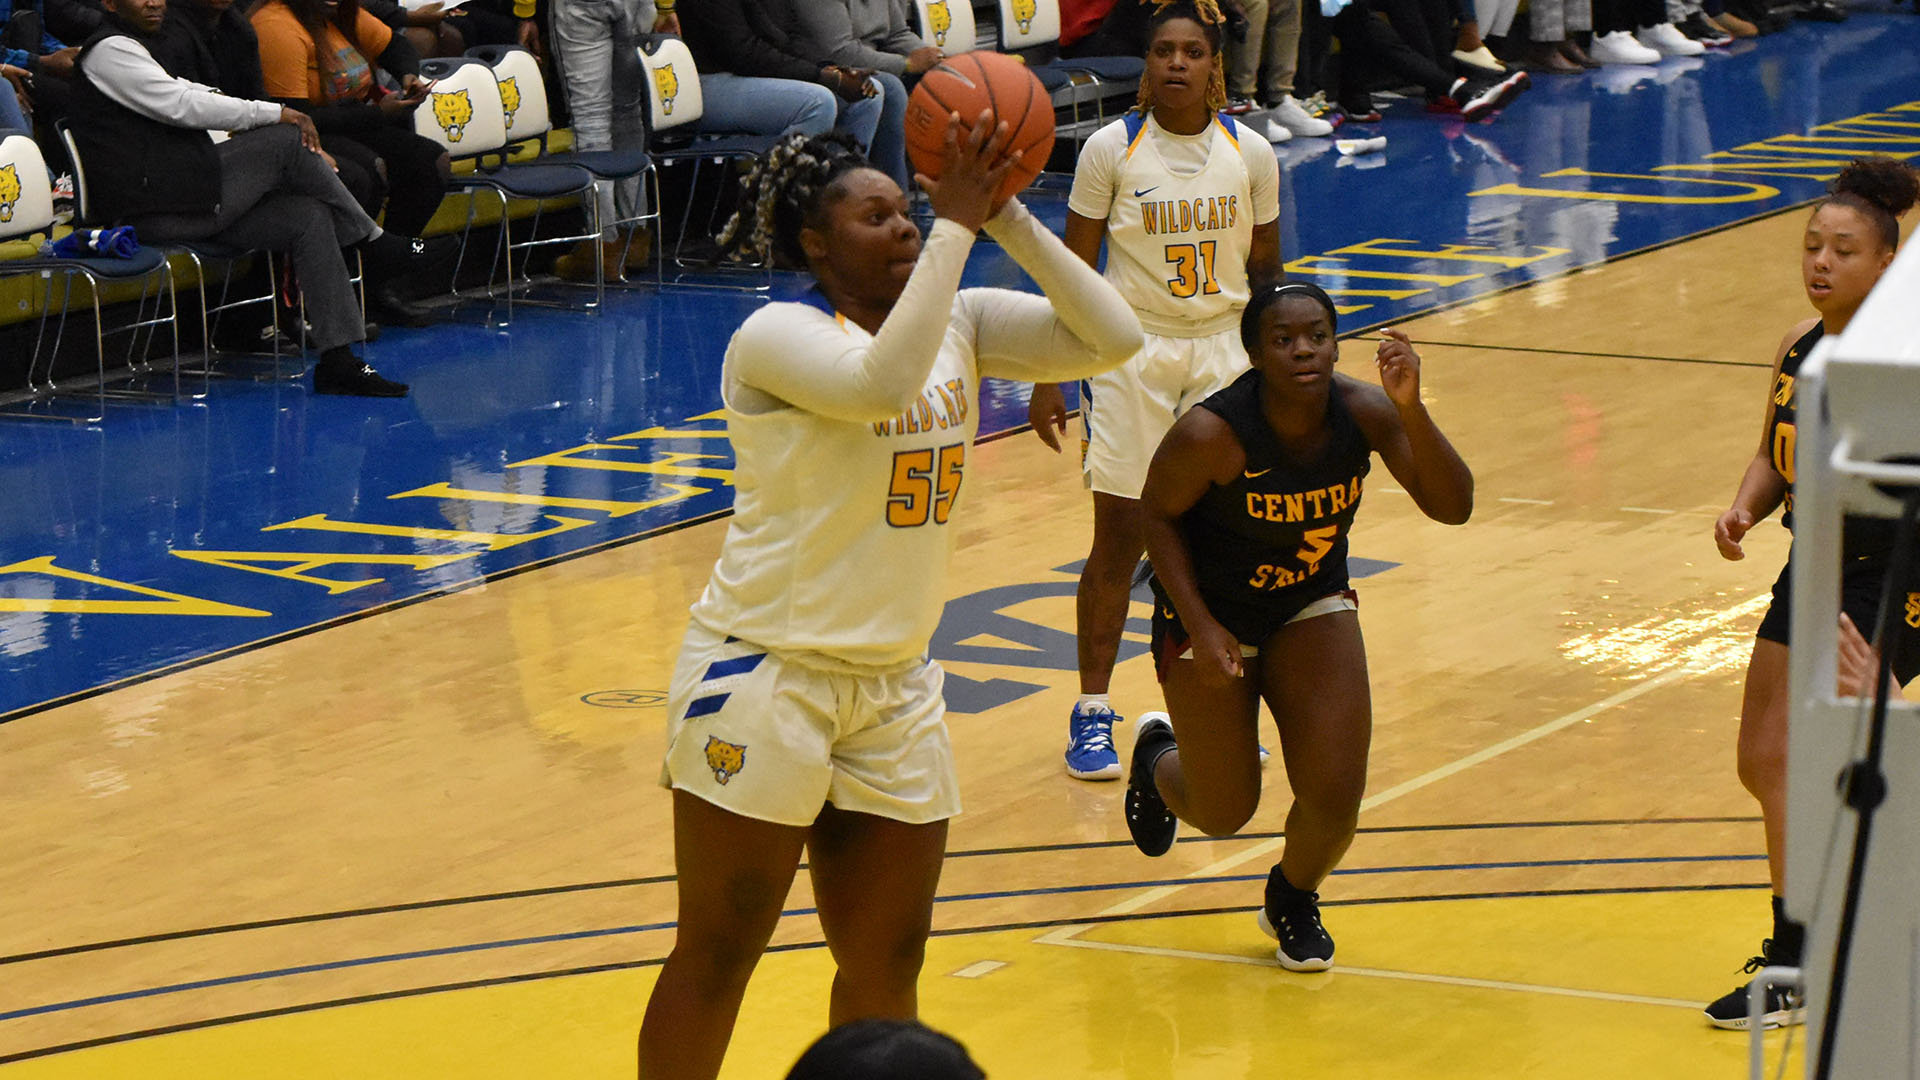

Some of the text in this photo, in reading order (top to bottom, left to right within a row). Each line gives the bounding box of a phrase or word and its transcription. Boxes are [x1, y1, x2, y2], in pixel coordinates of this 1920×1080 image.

[1141, 195, 1237, 235] WILDCATS
[1165, 240, 1221, 298] 31
[886, 442, 965, 529] 55
[1246, 475, 1364, 523] CENTRA
[1296, 524, 1338, 565] 5
